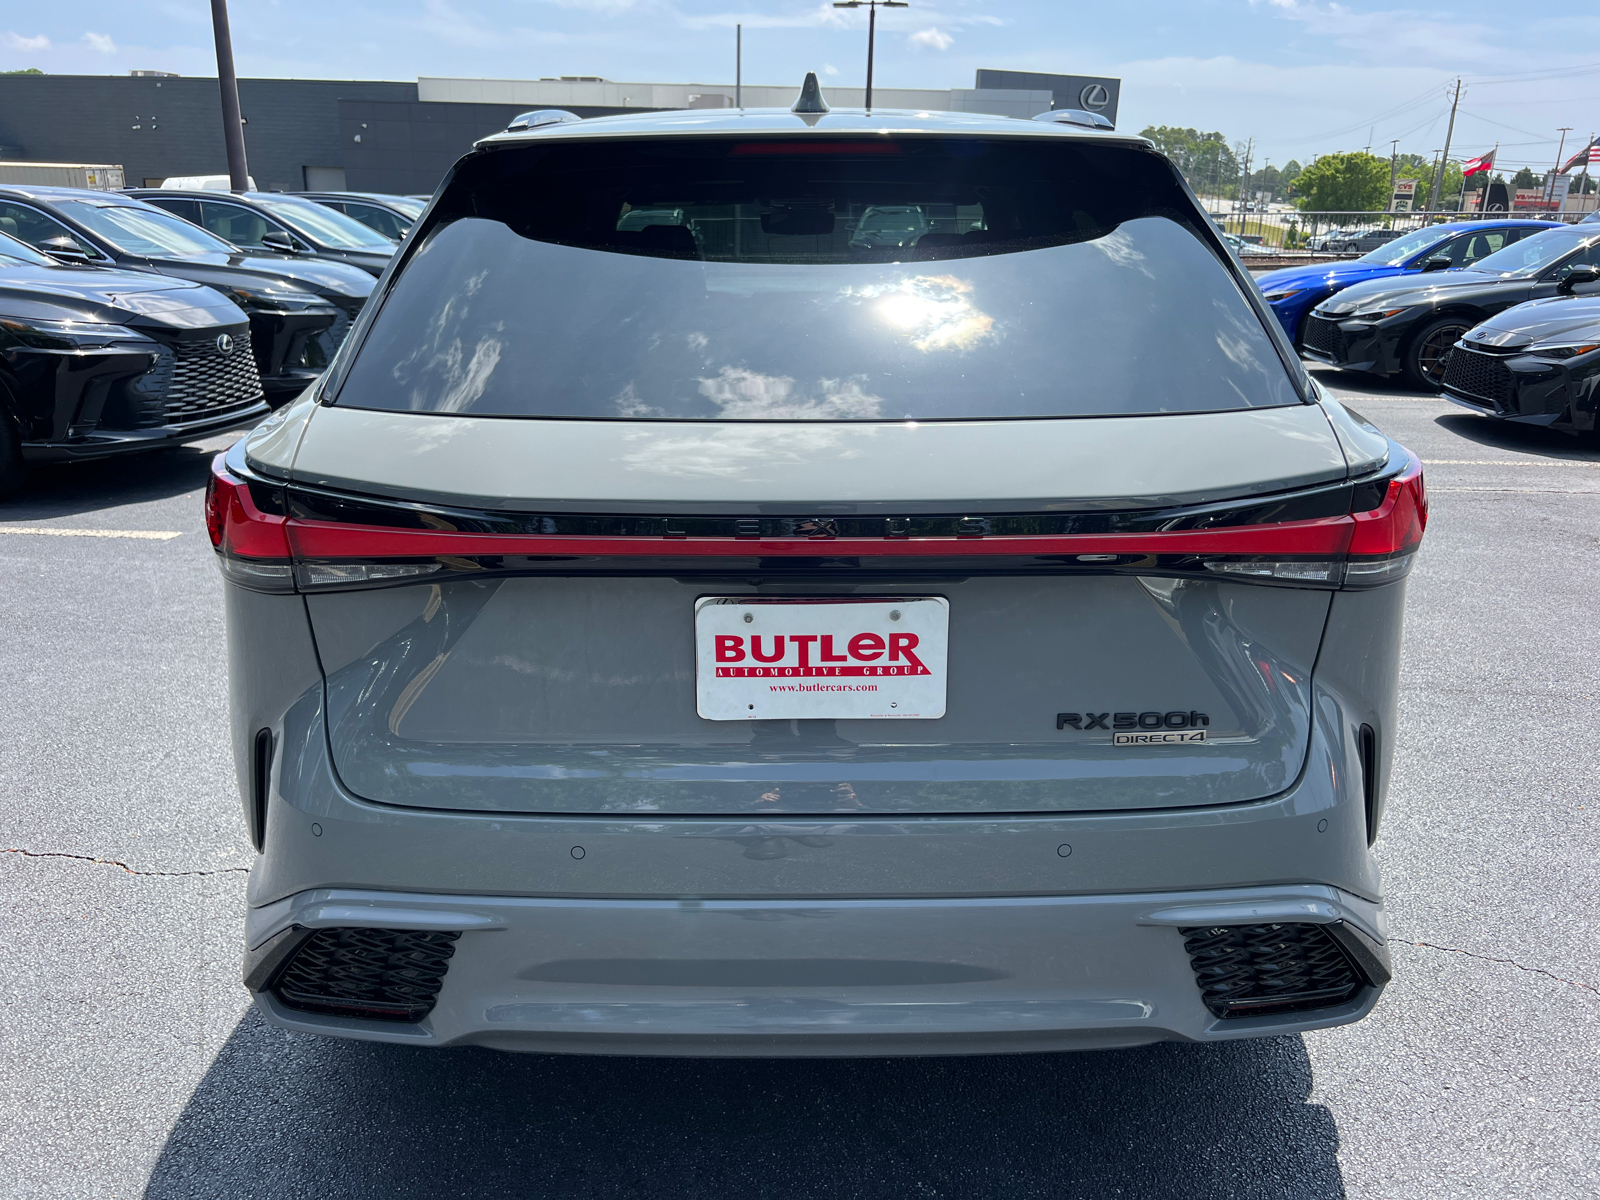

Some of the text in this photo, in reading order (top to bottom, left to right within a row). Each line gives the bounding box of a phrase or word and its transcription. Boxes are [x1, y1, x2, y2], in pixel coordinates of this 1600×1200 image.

[662, 517, 986, 536] LEXUS
[716, 665, 925, 677] AUTOMOTIVE GROUP
[769, 683, 878, 693] www.butlercars.com
[1115, 731, 1206, 745] DIRECT4
